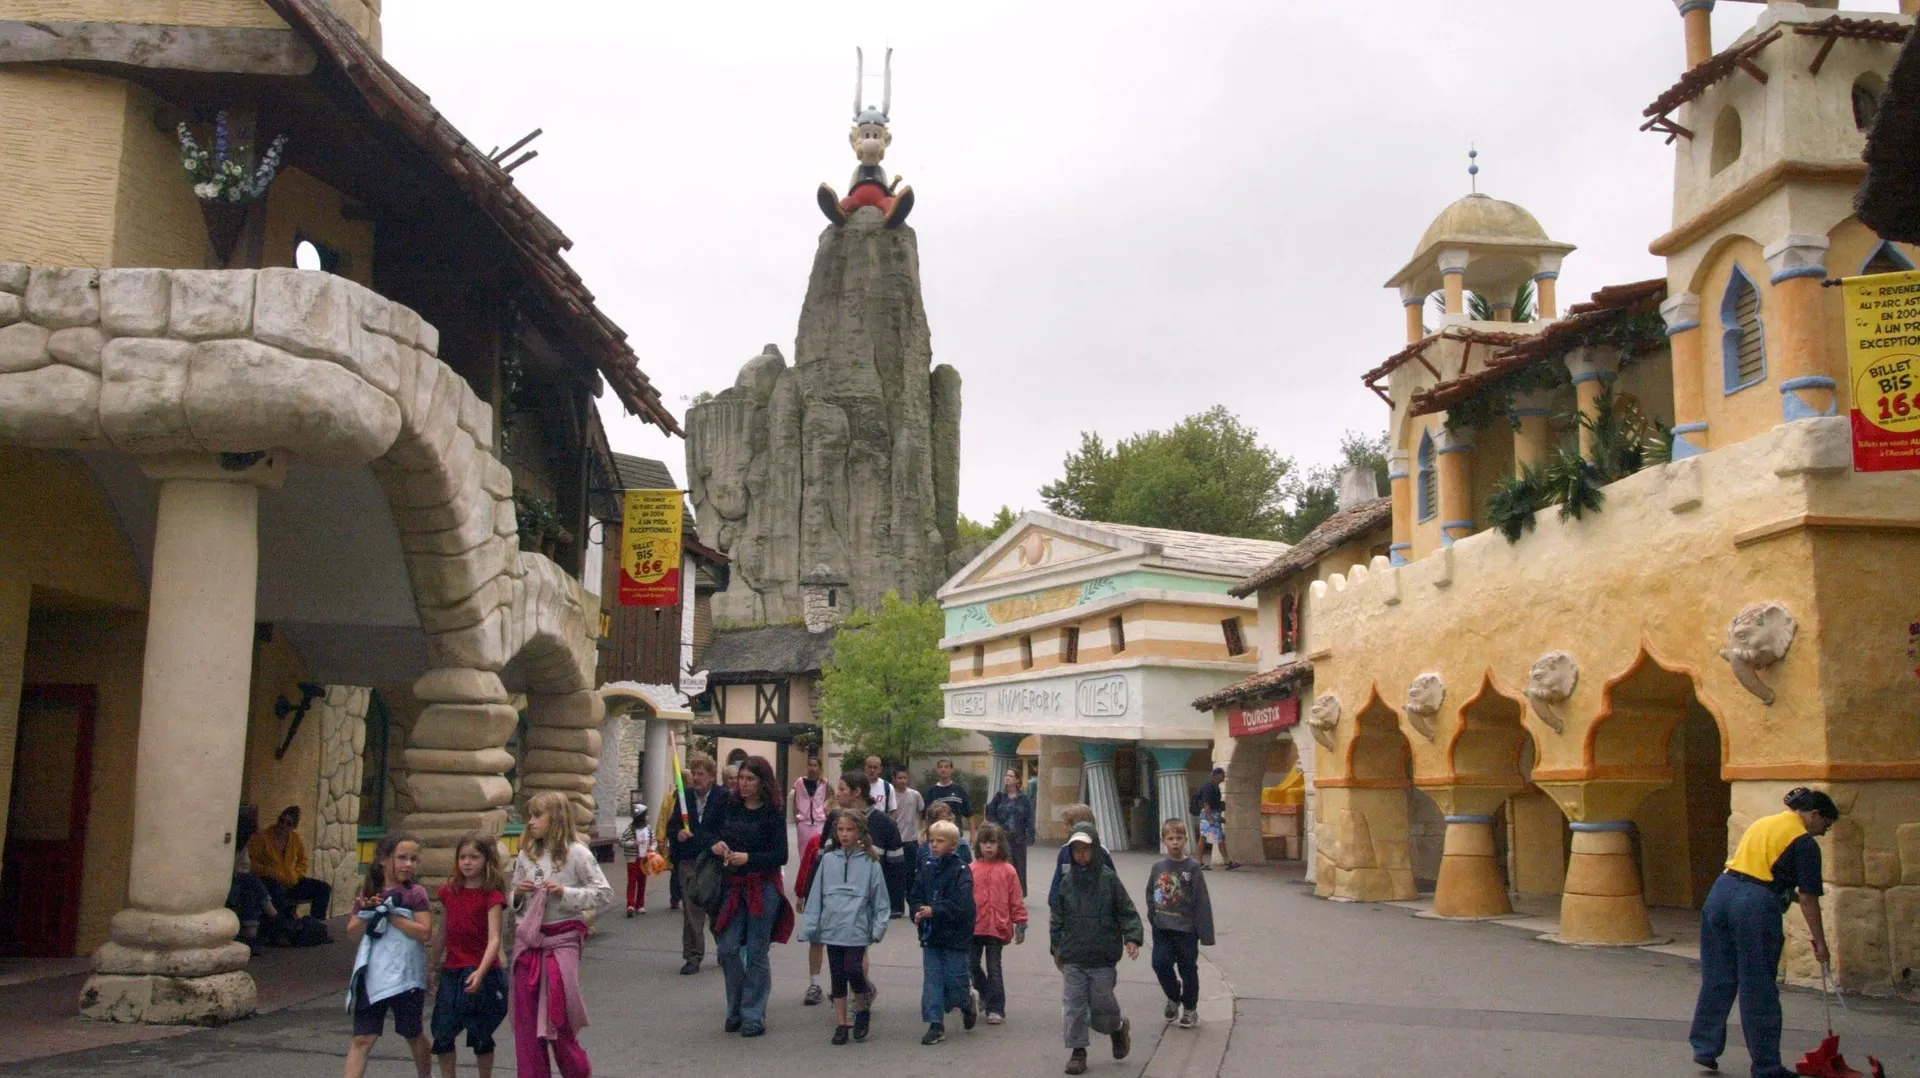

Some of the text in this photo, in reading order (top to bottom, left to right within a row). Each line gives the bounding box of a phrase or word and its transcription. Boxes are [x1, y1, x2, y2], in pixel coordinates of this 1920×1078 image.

[1879, 284, 1920, 296] REVENEZ
[1860, 301, 1872, 310] AU
[1874, 299, 1901, 309] PARC
[1881, 312, 1893, 321] EN
[1885, 323, 1901, 334] UN
[1869, 359, 1911, 378] BILLET
[634, 559, 664, 576] 16€
